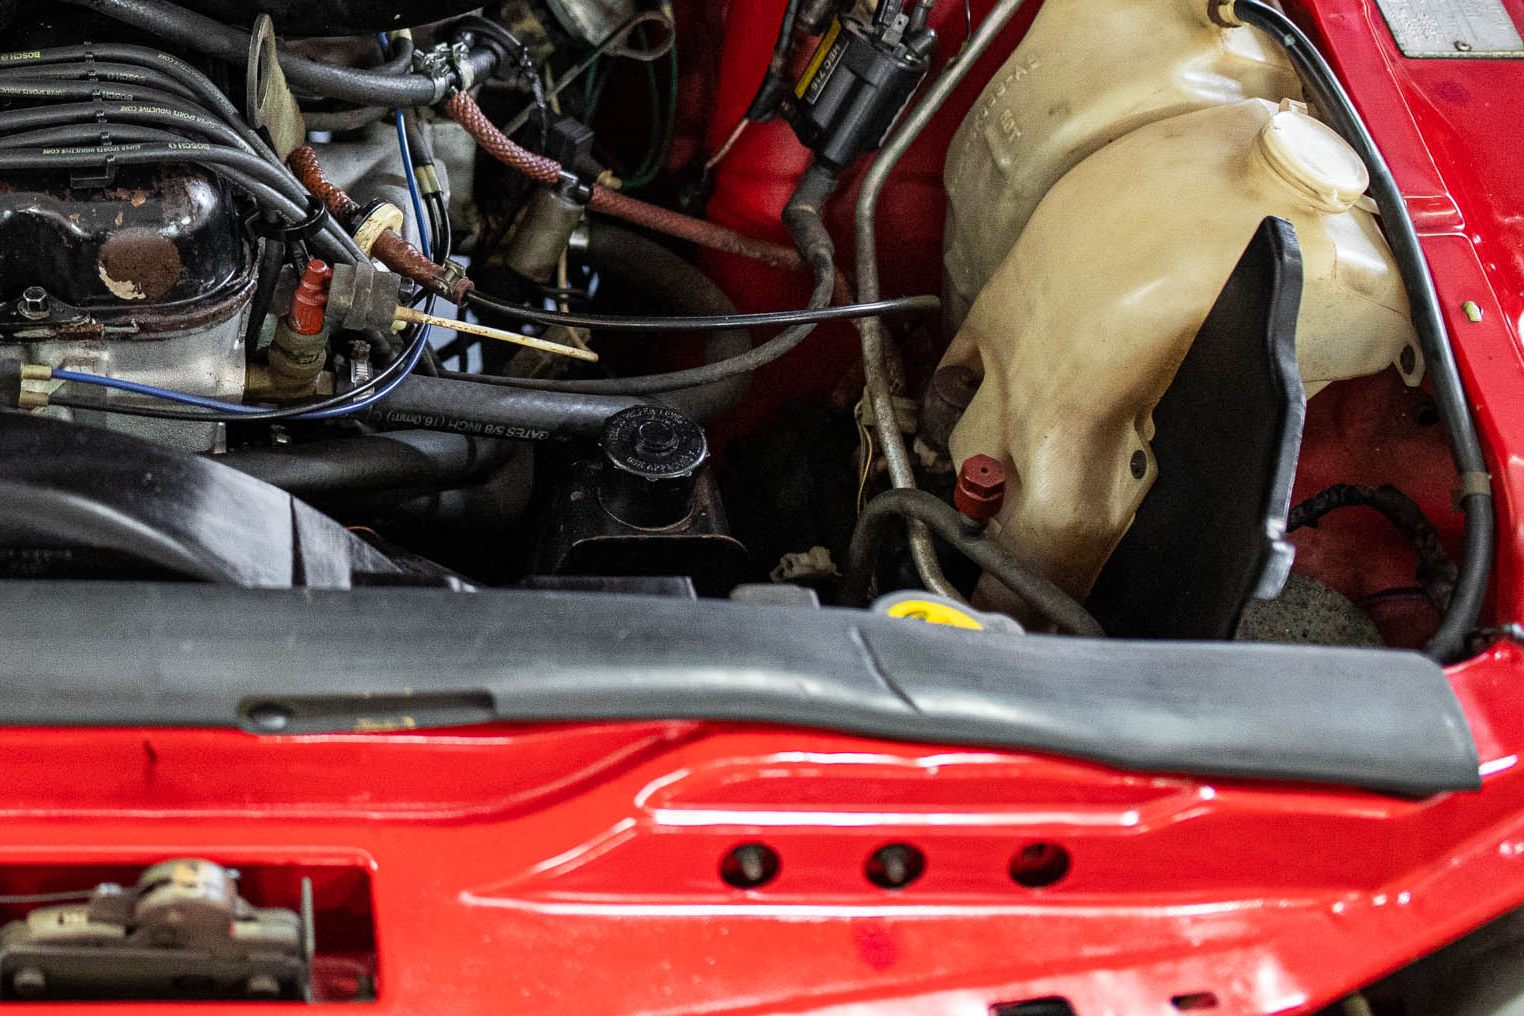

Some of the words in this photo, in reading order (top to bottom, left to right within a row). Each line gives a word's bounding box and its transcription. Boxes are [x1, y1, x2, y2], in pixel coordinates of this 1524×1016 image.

[10, 51, 41, 62] BOSCH
[102, 90, 133, 101] BOSCH
[120, 105, 137, 113] CORE
[139, 106, 172, 116] INDUCTIVE
[172, 110, 196, 121] SPORTS
[61, 147, 96, 155] INDUCTIVE
[96, 146, 120, 154] SPORTS
[177, 142, 210, 151] BOSCH
[484, 423, 505, 434] 5/8
[506, 427, 549, 441] GATES
